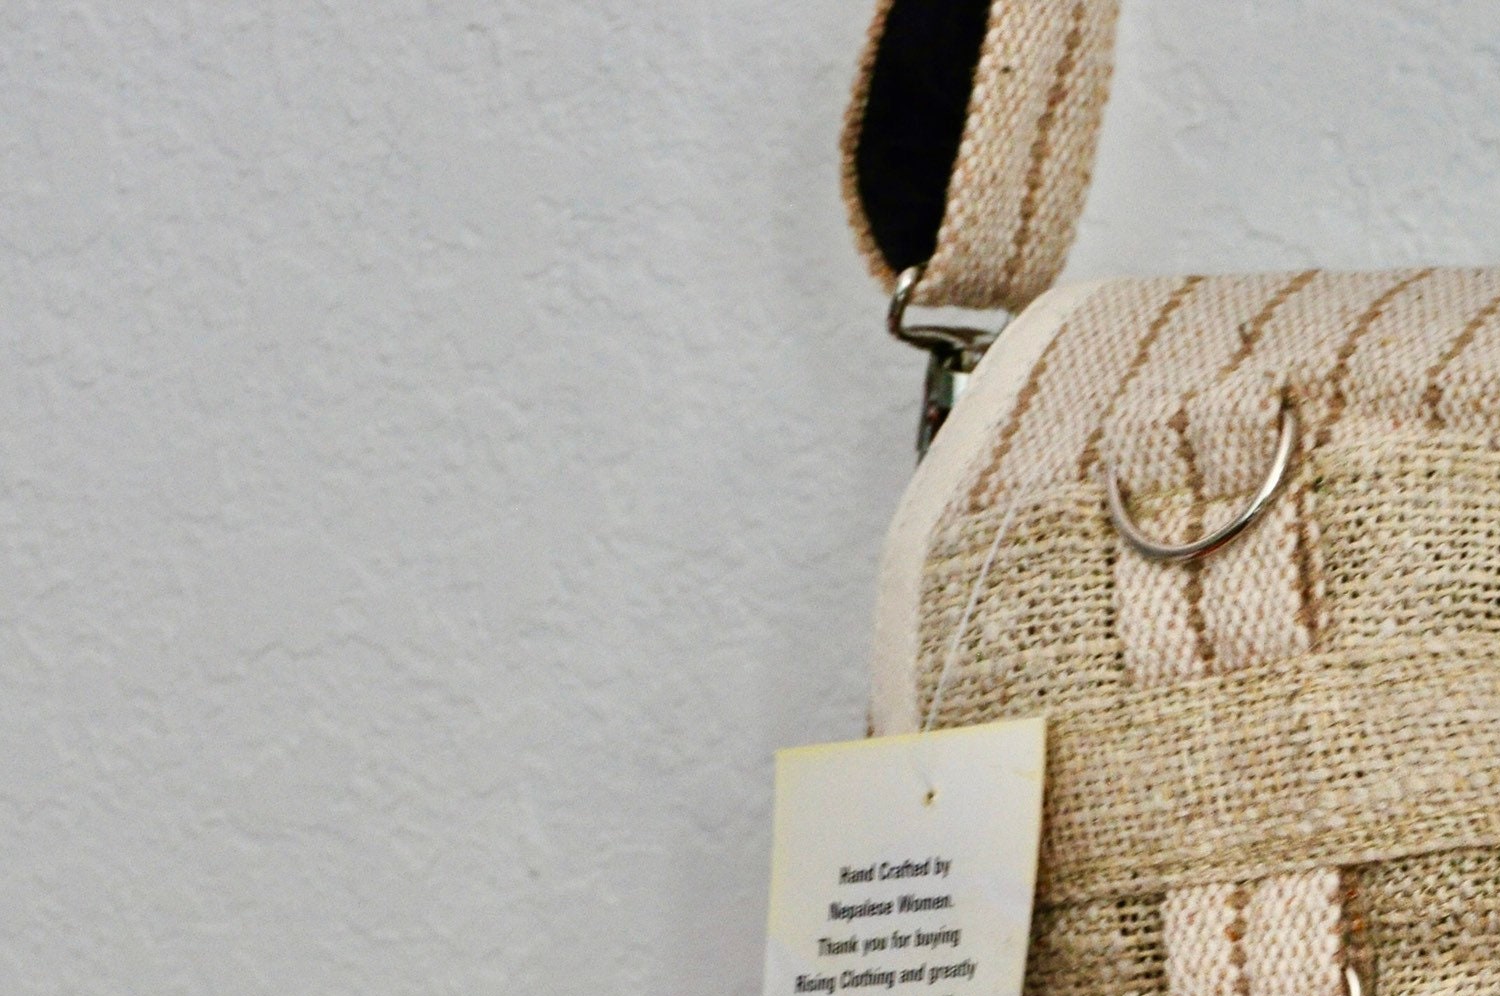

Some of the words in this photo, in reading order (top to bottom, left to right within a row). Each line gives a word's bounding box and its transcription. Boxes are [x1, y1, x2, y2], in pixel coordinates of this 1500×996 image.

[839, 863, 876, 884] Hand
[878, 858, 931, 880] Crafted
[934, 857, 952, 878] by
[828, 899, 894, 922] Nepalese
[898, 894, 953, 913] Women.
[818, 935, 858, 956] Thank
[862, 938, 888, 956] you
[890, 930, 912, 948] for
[914, 926, 962, 950] buying
[795, 973, 836, 994] Rising
[839, 968, 896, 989] Clothing
[899, 964, 926, 983] and
[929, 959, 978, 984] greatly
